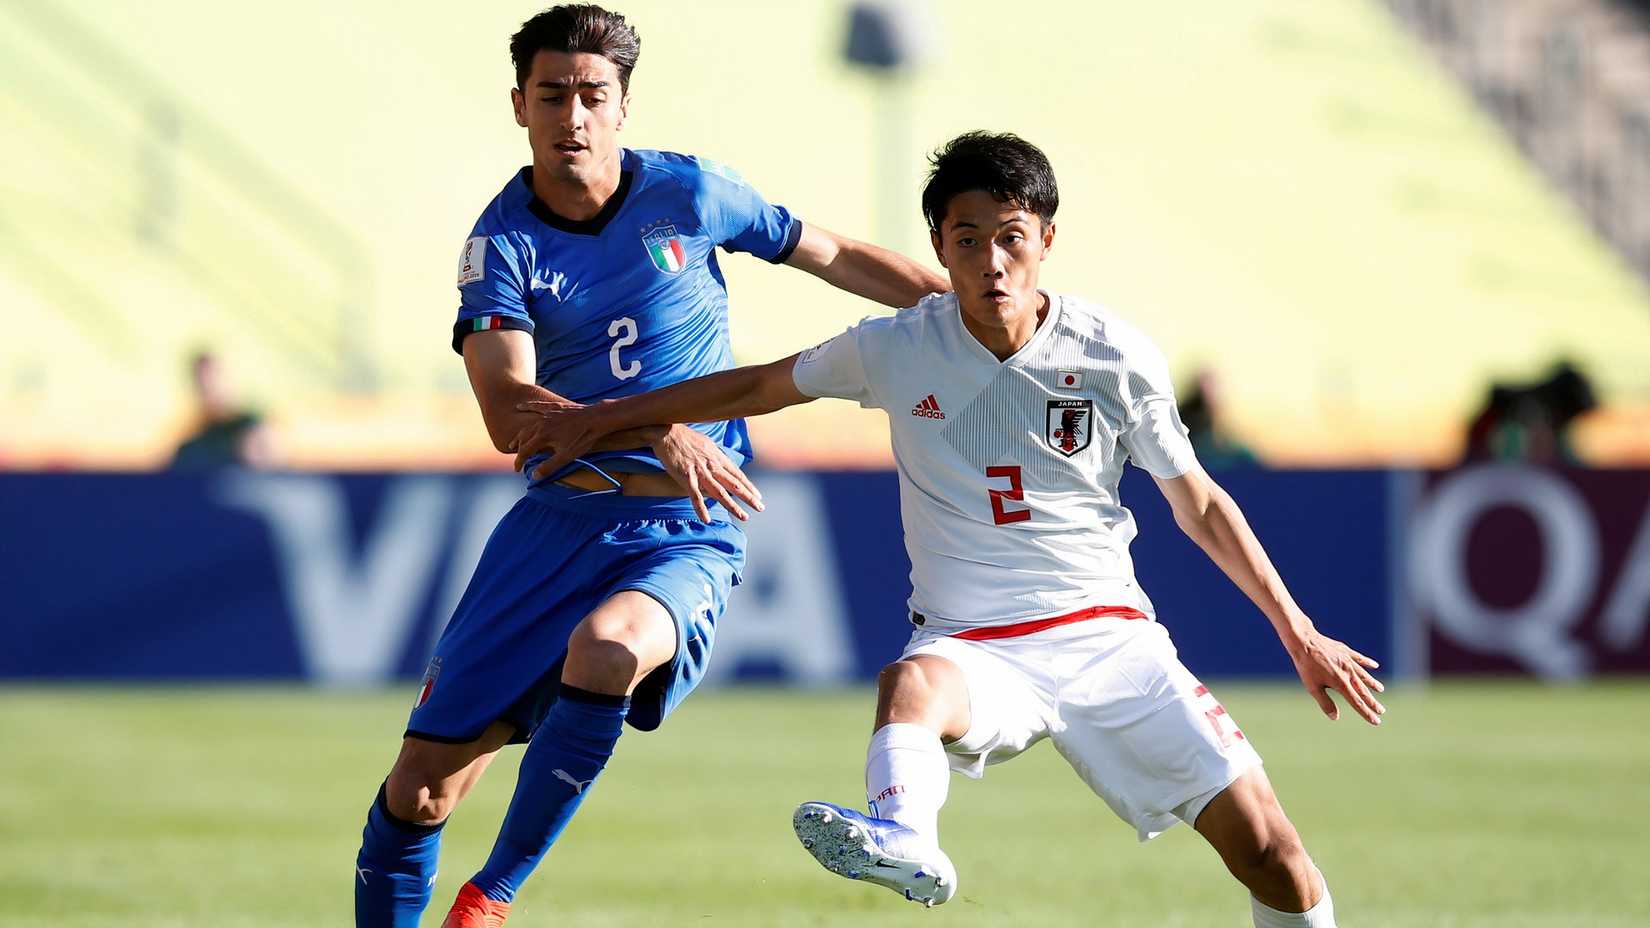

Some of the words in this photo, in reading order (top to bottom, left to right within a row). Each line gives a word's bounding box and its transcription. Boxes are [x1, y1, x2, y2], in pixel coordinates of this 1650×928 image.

[608, 317, 641, 380] 2
[912, 409, 945, 419] adidas
[986, 466, 1031, 525] 2
